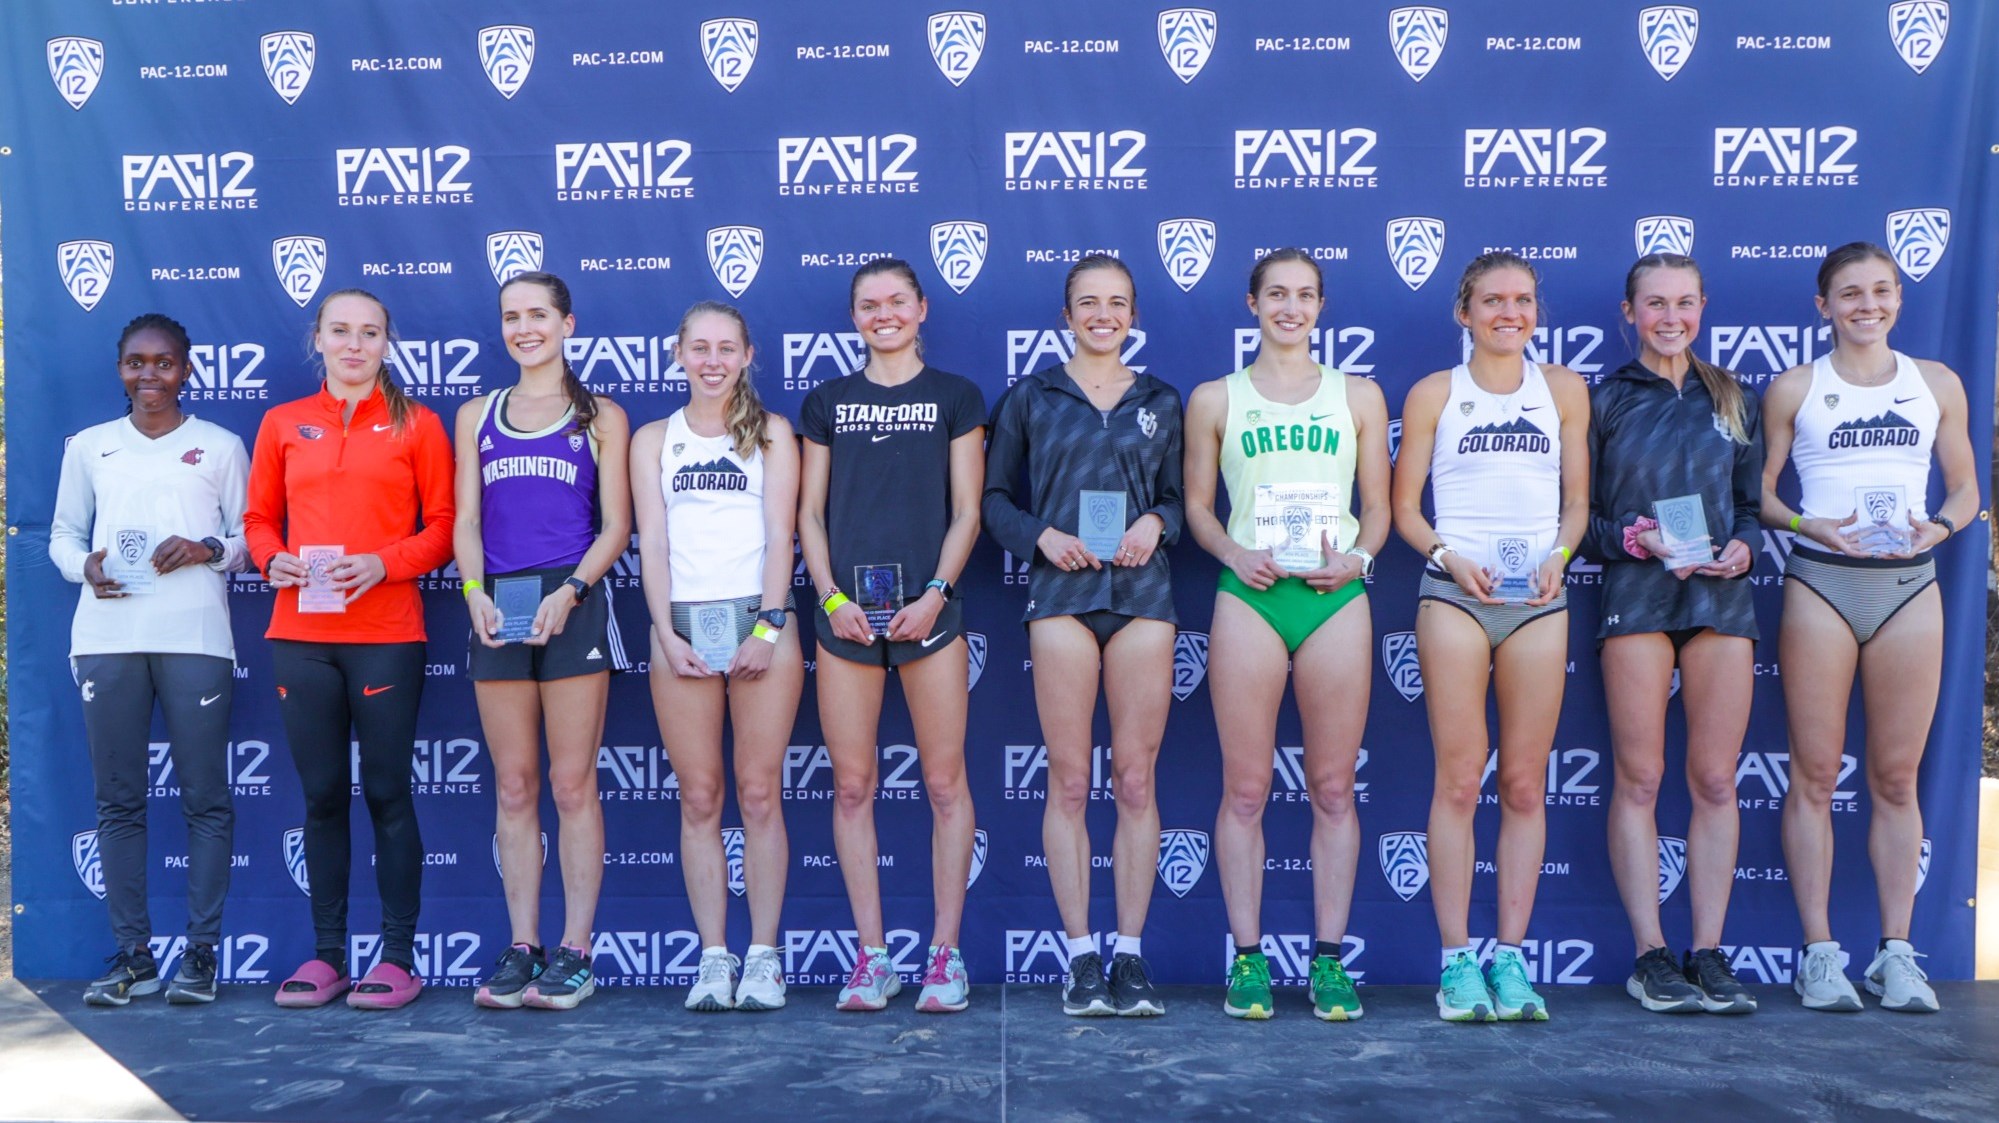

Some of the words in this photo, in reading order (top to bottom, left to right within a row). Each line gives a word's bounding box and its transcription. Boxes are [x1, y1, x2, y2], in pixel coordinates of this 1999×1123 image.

[1161, 11, 1213, 51] PAC
[1392, 10, 1445, 49] PAC
[1642, 9, 1695, 49] PAC
[1891, 4, 1946, 42] PAC
[703, 21, 755, 60] PAC
[930, 14, 983, 54] PAC
[1486, 37, 1581, 50] PAC-12.COM
[1737, 36, 1830, 49] PAC-12.COM
[263, 34, 312, 73] PAC
[481, 28, 532, 67] PAC
[797, 45, 890, 60] PAC-12.COM
[1025, 40, 1118, 54] PAC-12.COM
[1256, 38, 1350, 51] PAC-12.COM
[1908, 39, 1931, 58] 12
[50, 40, 101, 78] PAC
[352, 58, 442, 71] PAC-12.COM
[573, 52, 663, 65] PAC-12.COM
[947, 51, 969, 70] 12
[1177, 48, 1199, 67] 12
[1409, 46, 1431, 65] 12
[1659, 45, 1681, 65] 12
[140, 65, 227, 79] PAC-12.COM
[497, 64, 518, 83] 12
[720, 57, 741, 77] 12
[66, 75, 87, 94] 12
[279, 70, 298, 89] 12
[779, 183, 919, 195] CONFERENCE
[1006, 178, 1148, 191] CONFERENCE
[1234, 177, 1378, 188] CONFERENCE
[1464, 177, 1608, 188] CONFERENCE
[1714, 175, 1858, 186] CONFERENCE
[339, 194, 474, 206] CONFERENCE
[558, 188, 694, 200] CONFERENCE
[125, 199, 258, 212] CONFERENCE
[1390, 220, 1442, 259] PAC
[1639, 219, 1690, 258] PAC
[1890, 211, 1947, 250] PAC
[709, 229, 760, 267] PAC
[932, 224, 985, 263] PAC
[1161, 221, 1212, 260] PAC
[60, 243, 111, 280] PAC
[275, 238, 323, 276] PAC
[490, 234, 540, 273] PAC
[1732, 246, 1827, 259] PAC-12.COM
[1908, 247, 1931, 266] 12
[152, 267, 240, 280] PAC-12.COM
[363, 262, 452, 276] PAC-12.COM
[580, 257, 670, 271] PAC-12.COM
[726, 264, 746, 283] 12
[949, 260, 970, 279] 12
[1177, 257, 1198, 276] 12
[1406, 256, 1428, 275] 12
[77, 277, 97, 295] 12
[290, 273, 310, 291] 12
[783, 333, 866, 378] PAC
[1711, 326, 1832, 372] PAC1
[178, 390, 268, 400] FERENCE
[404, 386, 482, 396] ERENCE
[835, 403, 938, 425] STANFORD
[835, 424, 874, 433] CROSS
[877, 423, 935, 432] COUNTRY
[1241, 424, 1340, 458] OREGON
[1458, 435, 1550, 454] COLORADO
[1828, 429, 1920, 449] COLORADO
[482, 456, 578, 486] WASHINGTON
[673, 473, 748, 492] COLORADO
[1275, 493, 1329, 501] CHAMPIONSHIPS
[603, 853, 674, 865] C-12.COM
[1170, 866, 1192, 884] 12
[1397, 869, 1419, 888] 12
[591, 931, 700, 975] AC12
[1006, 974, 1068, 985] CONFE
